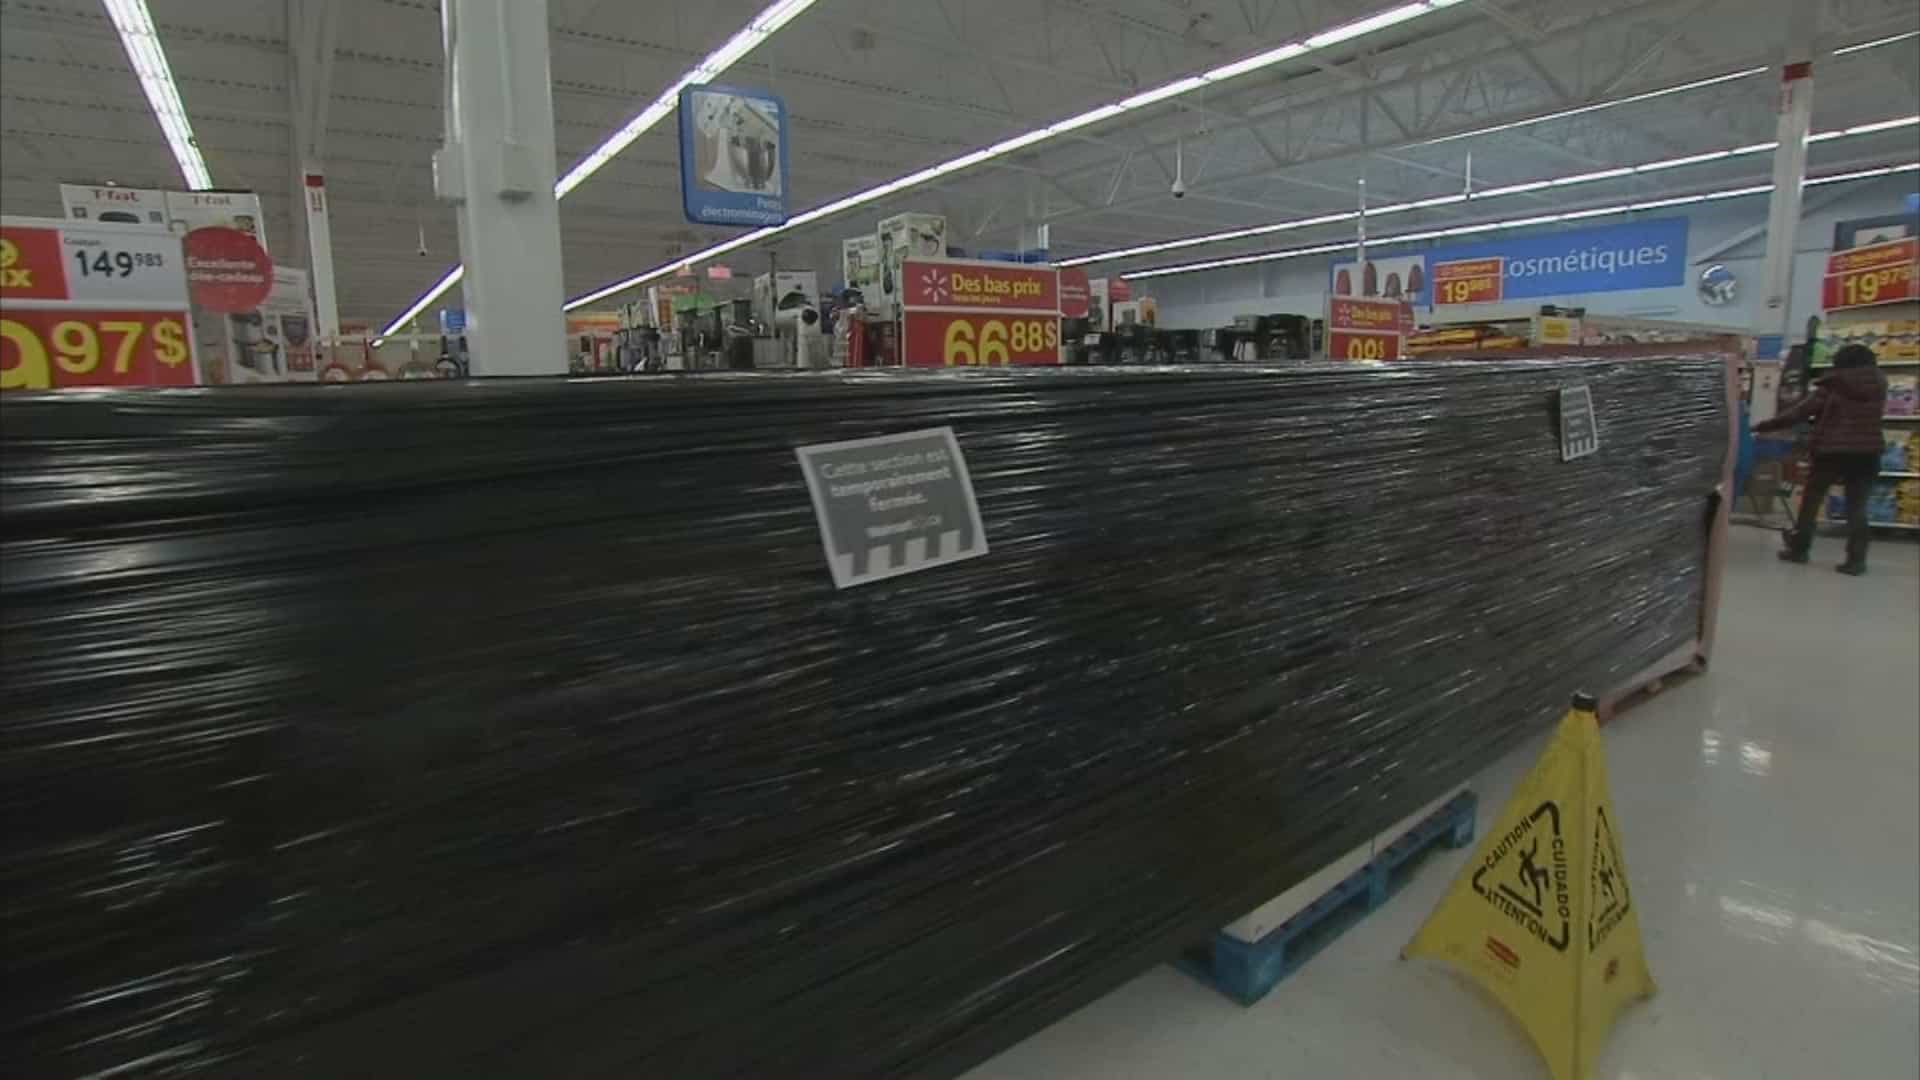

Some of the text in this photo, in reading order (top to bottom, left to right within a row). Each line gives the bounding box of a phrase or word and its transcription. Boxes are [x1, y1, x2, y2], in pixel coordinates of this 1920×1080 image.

[951, 272, 981, 292] Des
[983, 274, 1012, 295] bas
[1012, 277, 1042, 299] prix
[1503, 243, 1669, 278] osmétiques
[1485, 815, 1532, 869] CAUTION
[1552, 838, 1570, 918] CUIDADO
[1485, 888, 1549, 943] ATTENTION
